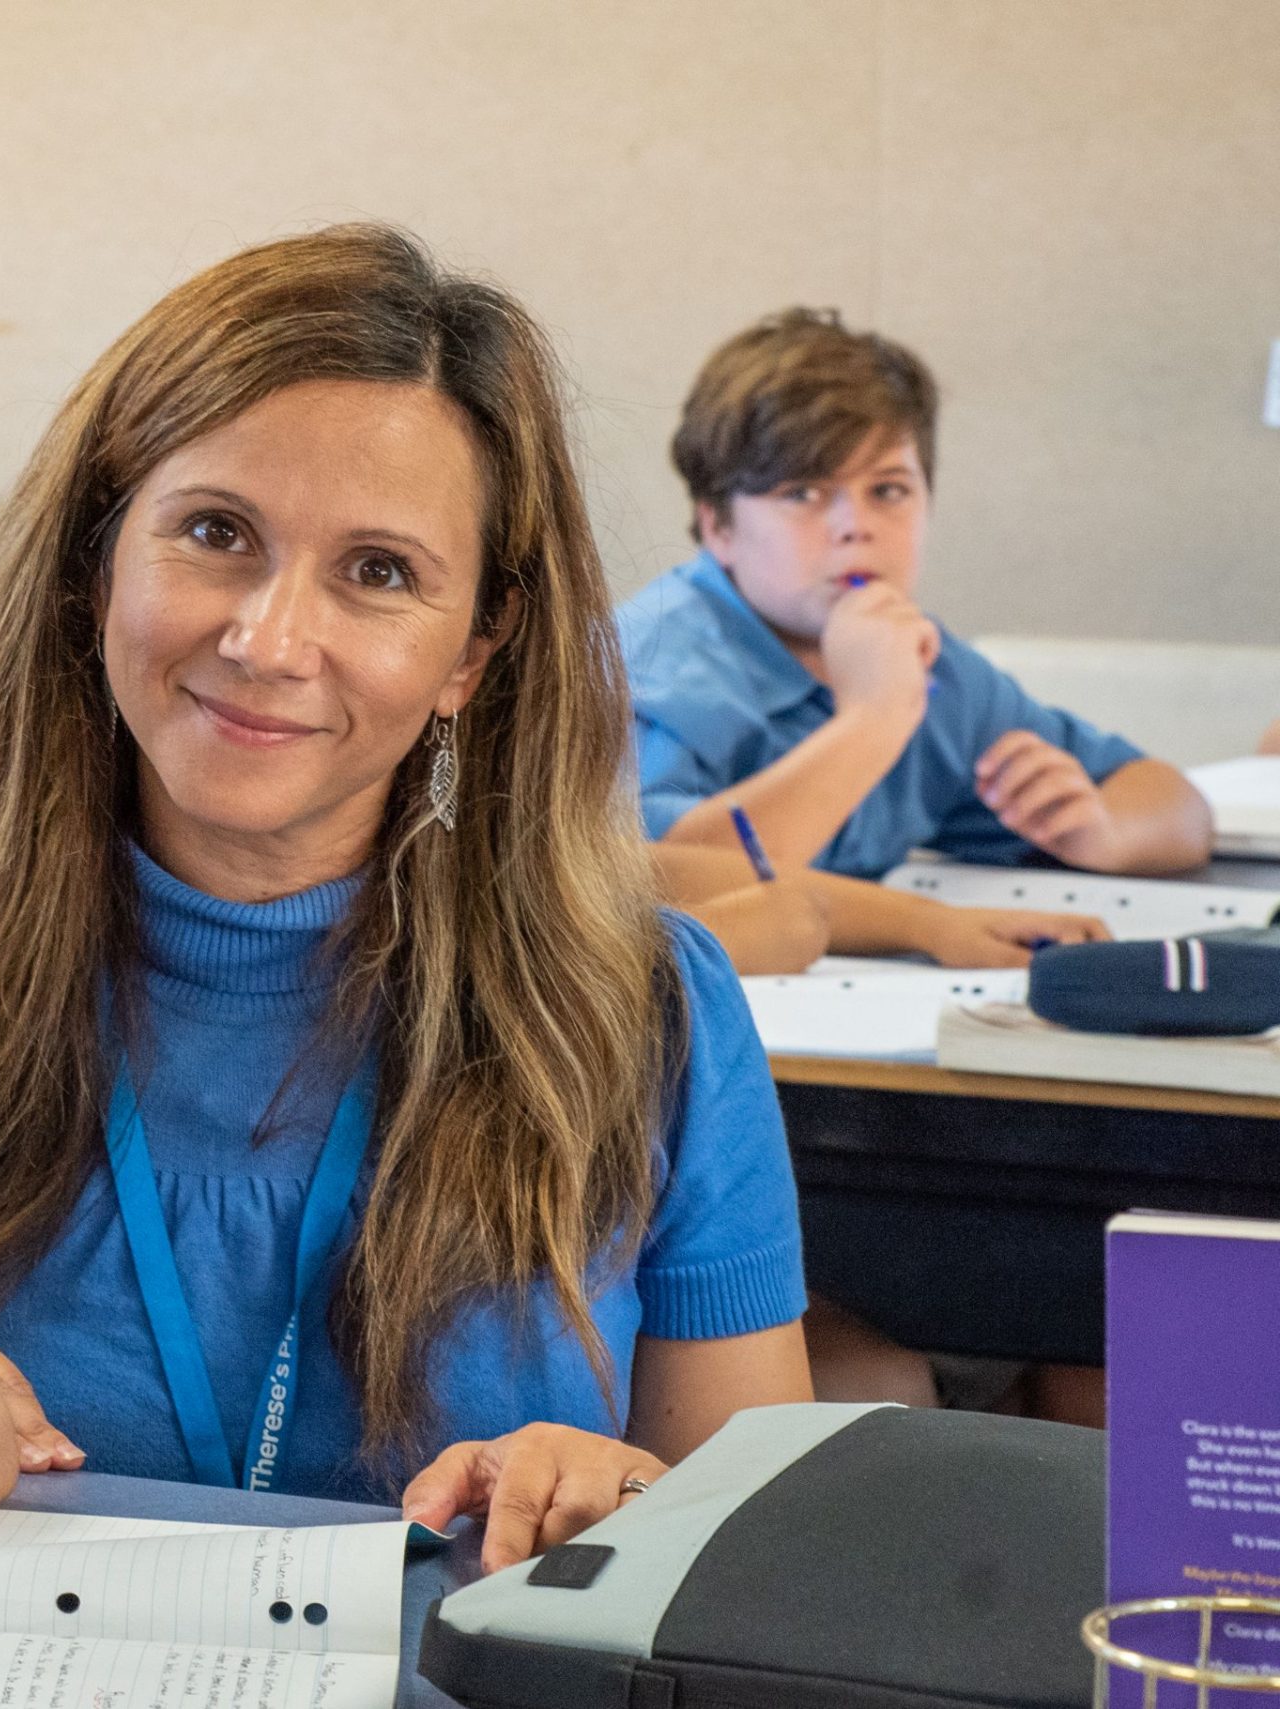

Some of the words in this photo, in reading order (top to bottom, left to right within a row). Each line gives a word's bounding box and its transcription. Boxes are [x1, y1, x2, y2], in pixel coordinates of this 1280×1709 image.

[250, 1362, 290, 1491] Therese's
[1181, 1420, 1219, 1436] Clara
[1233, 1425, 1257, 1440] the
